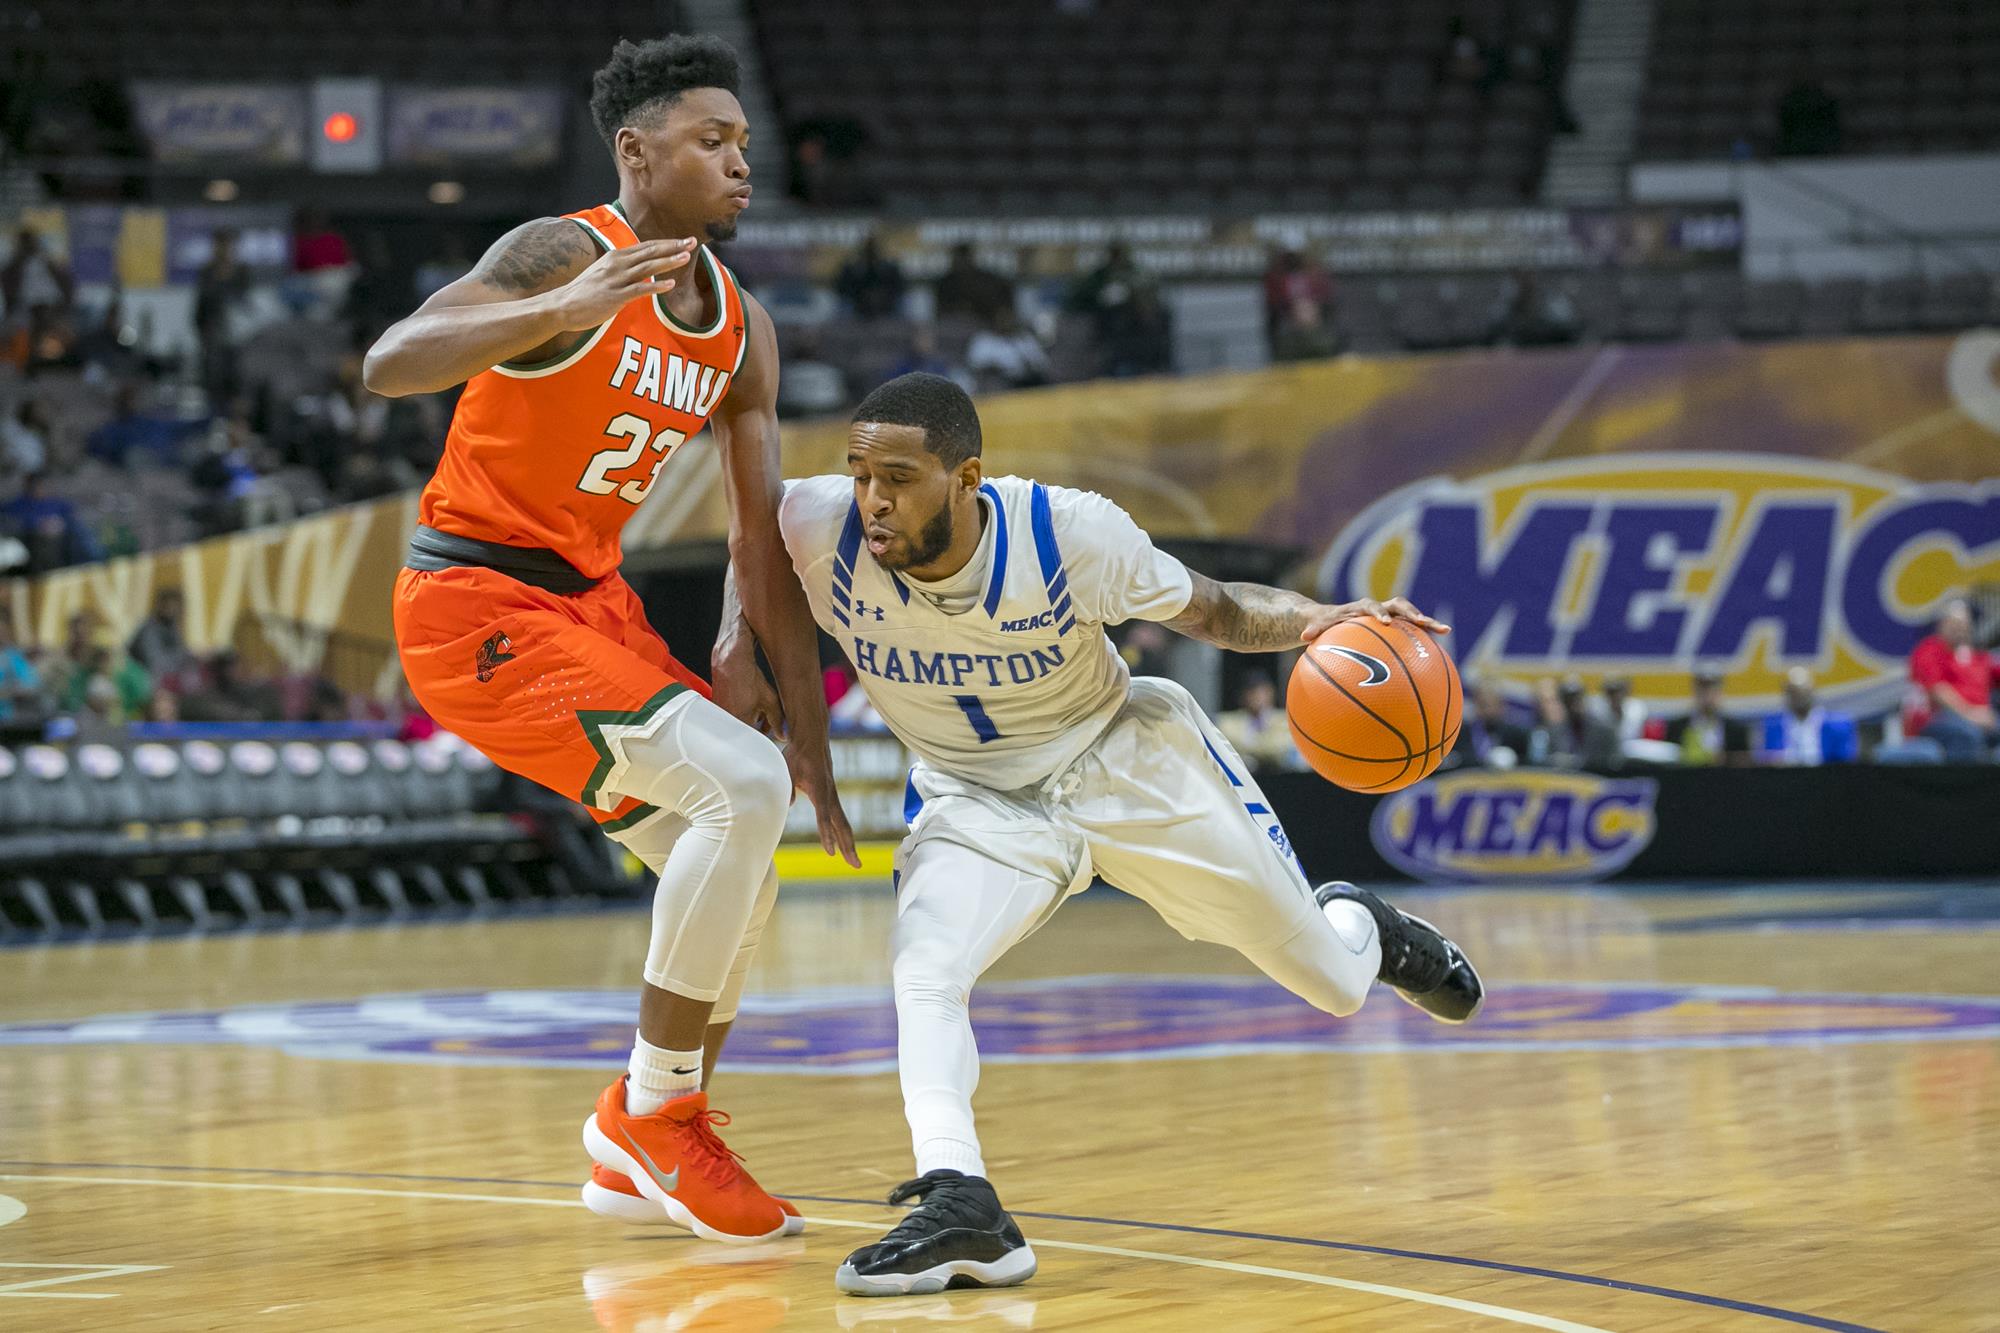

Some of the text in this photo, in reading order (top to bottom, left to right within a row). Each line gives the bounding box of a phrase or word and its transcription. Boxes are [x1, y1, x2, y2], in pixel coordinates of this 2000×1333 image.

[608, 335, 730, 418] FAMU
[576, 411, 687, 505] 23
[1394, 499, 2000, 657] MEAC
[1000, 609, 1052, 632] MEAC
[853, 636, 1065, 687] HAMPTON
[952, 694, 1000, 744] 1
[1400, 788, 1642, 858] MEAC
